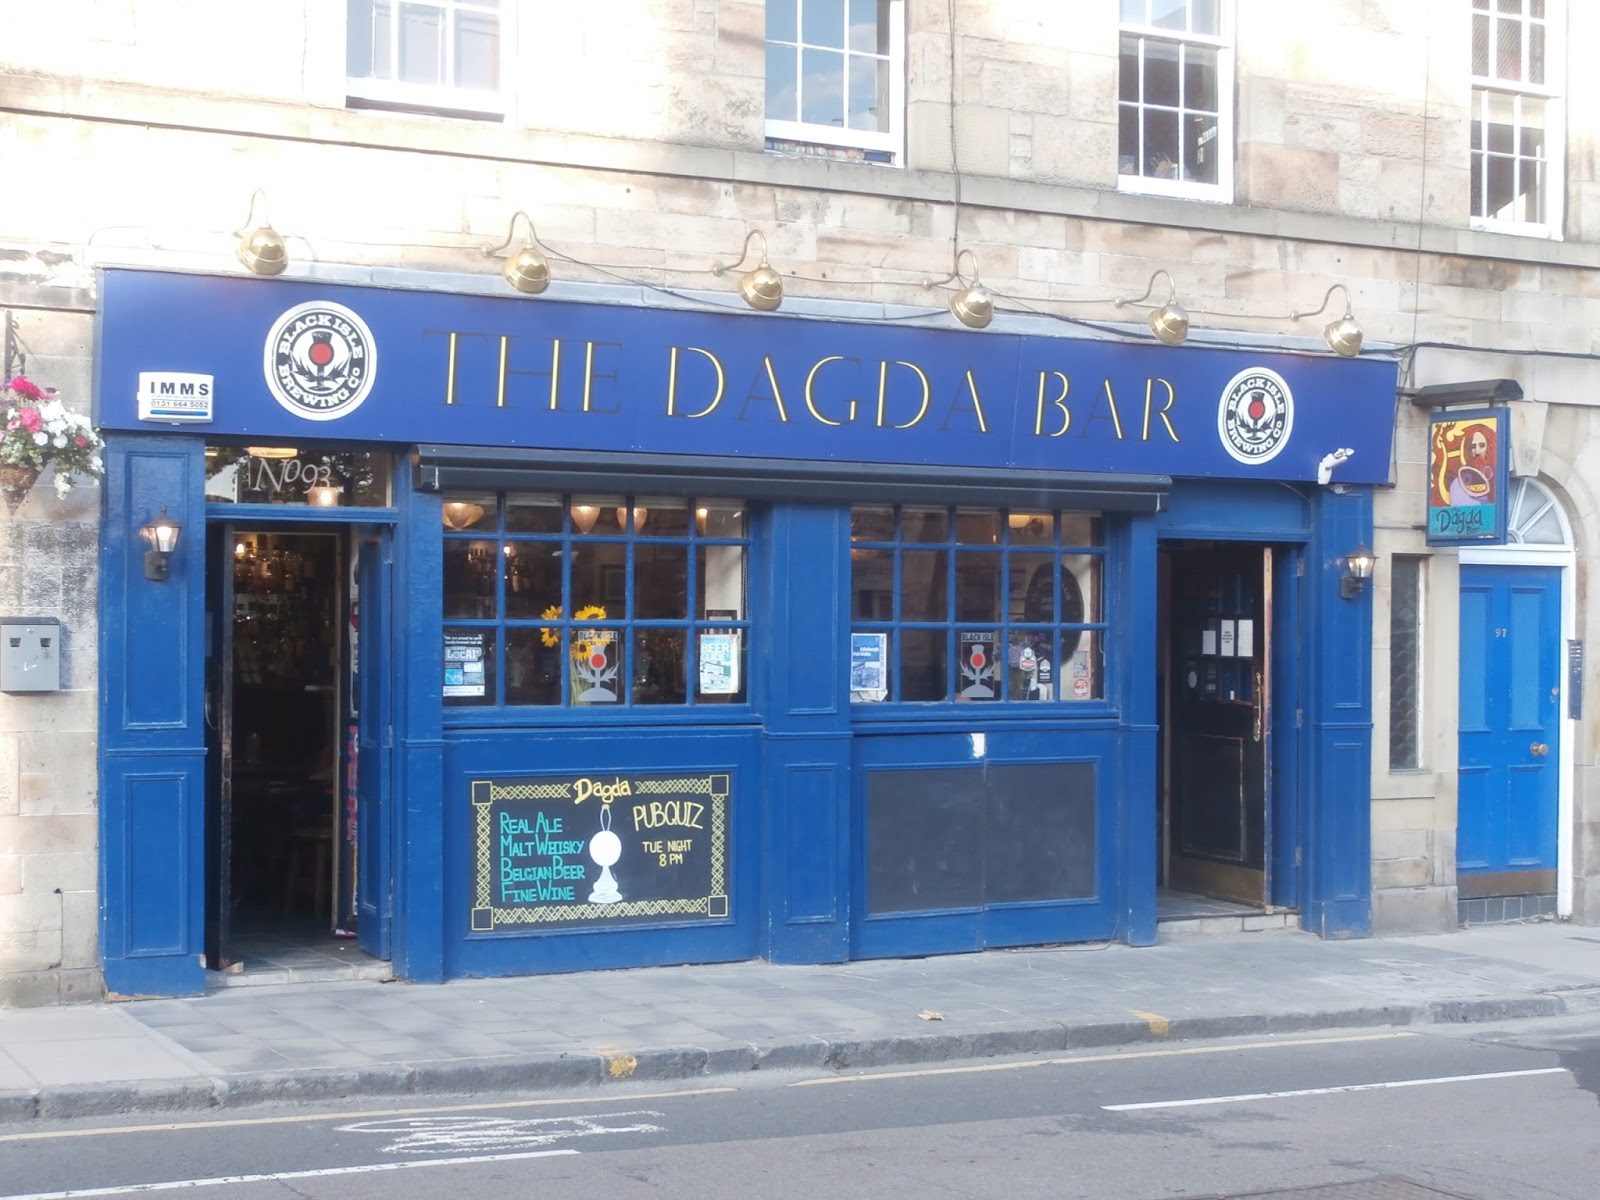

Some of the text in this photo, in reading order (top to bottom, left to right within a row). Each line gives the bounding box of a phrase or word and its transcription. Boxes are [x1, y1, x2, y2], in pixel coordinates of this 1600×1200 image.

[279, 314, 363, 359] BLACK ISLE
[151, 381, 209, 396] IMMS
[278, 364, 360, 407] BREWING CO
[421, 329, 1182, 443] THE DAGDA BAR
[1228, 378, 1285, 414] BLACK ISLE
[1227, 419, 1282, 453] BREWING CO
[1436, 508, 1484, 534] Dagda
[962, 633, 994, 641] BLACK ISLE
[1494, 628, 1507, 638] 97
[573, 777, 631, 805] Dagda
[500, 811, 563, 834] REAL ALE
[500, 833, 585, 857] MALT WHISKY
[642, 839, 693, 853] TUE NIGHT
[501, 855, 586, 881] BELGIAN BEER
[659, 853, 683, 867] 8 PM
[501, 879, 575, 902] FINE WINE
